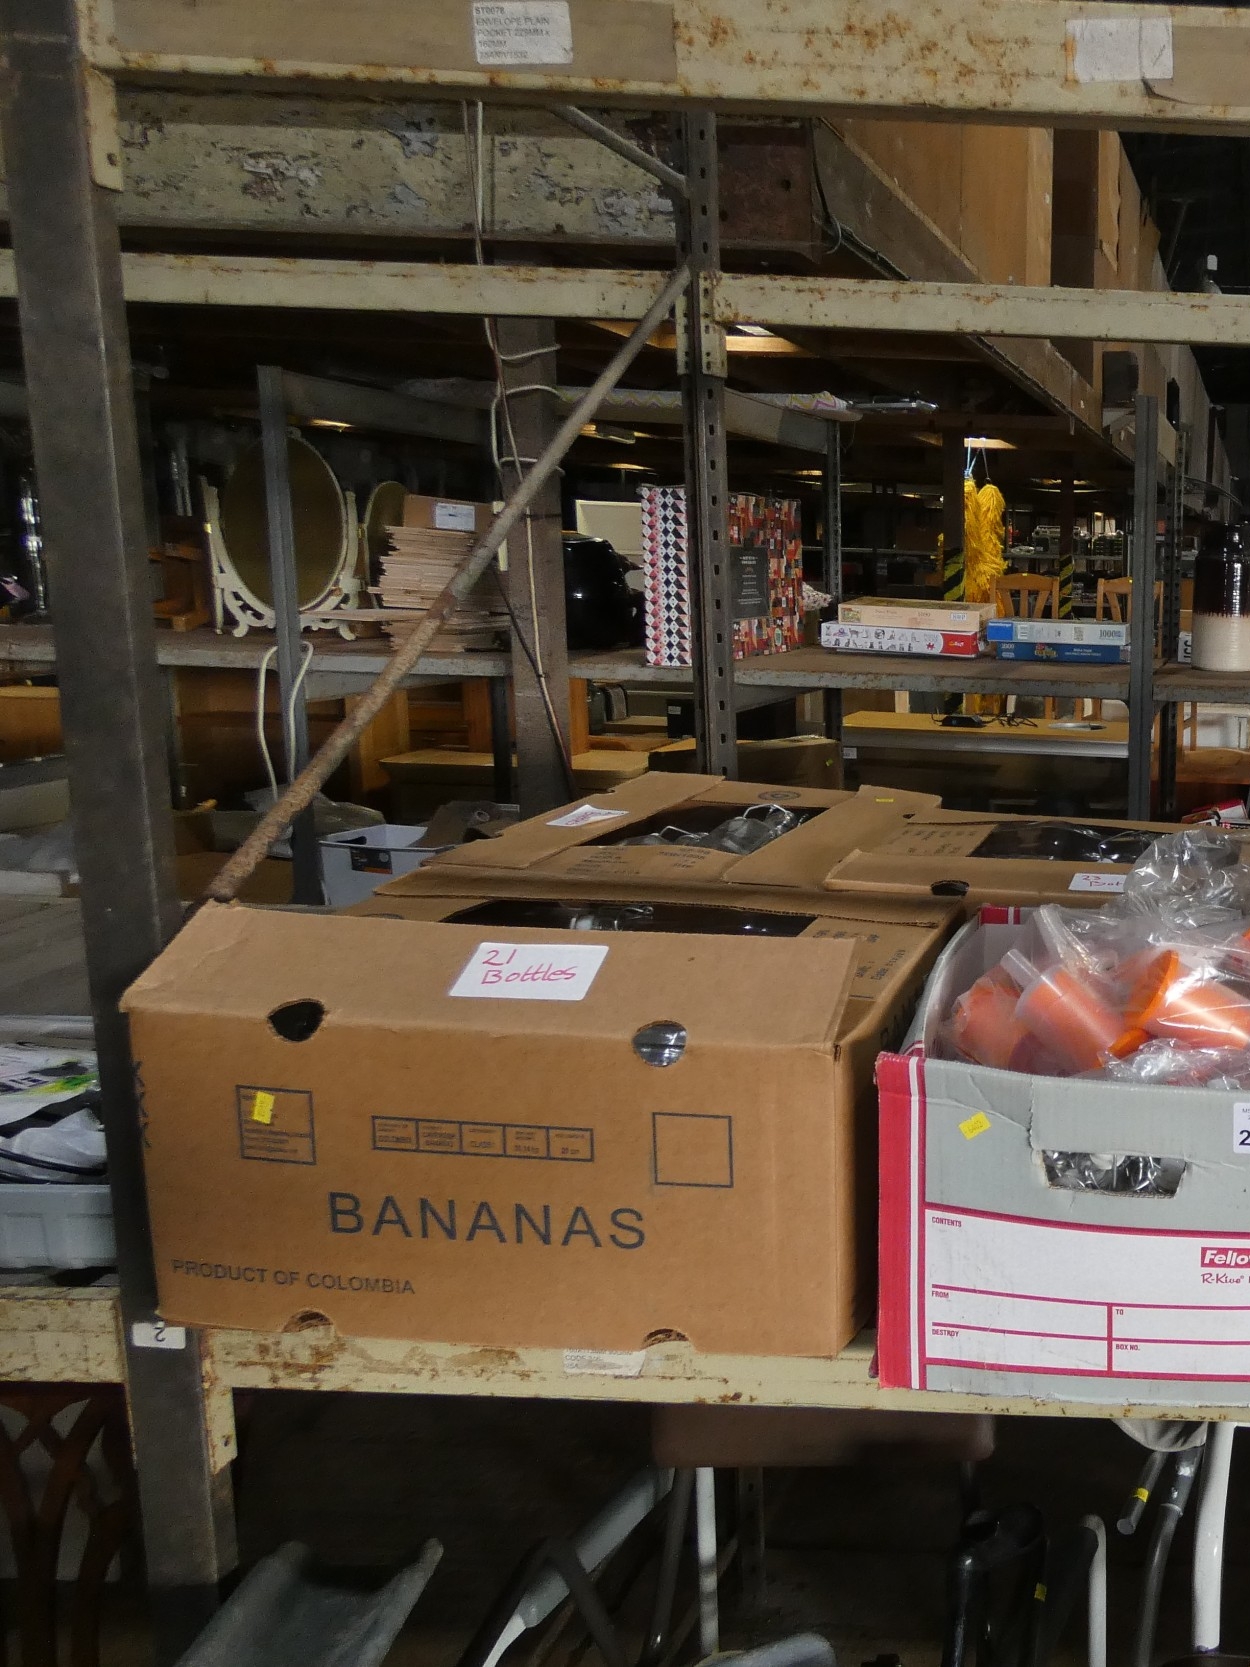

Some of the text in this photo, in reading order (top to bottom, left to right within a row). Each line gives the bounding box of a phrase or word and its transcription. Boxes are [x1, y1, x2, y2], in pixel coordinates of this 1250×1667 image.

[476, 17, 549, 26] ENVELOPE PLAIN
[478, 29, 512, 37] POCKET
[482, 948, 518, 967] 21
[480, 963, 578, 985] Bottles
[327, 1191, 646, 1251] BANANAS
[931, 1216, 962, 1228] CONTENTS
[171, 1258, 416, 1295] PRODUCT OF COLOMBIA
[931, 1290, 949, 1299] FROM
[1115, 1308, 1124, 1316] TO
[931, 1328, 960, 1338] DESTROY
[1115, 1343, 1129, 1351] BOX
